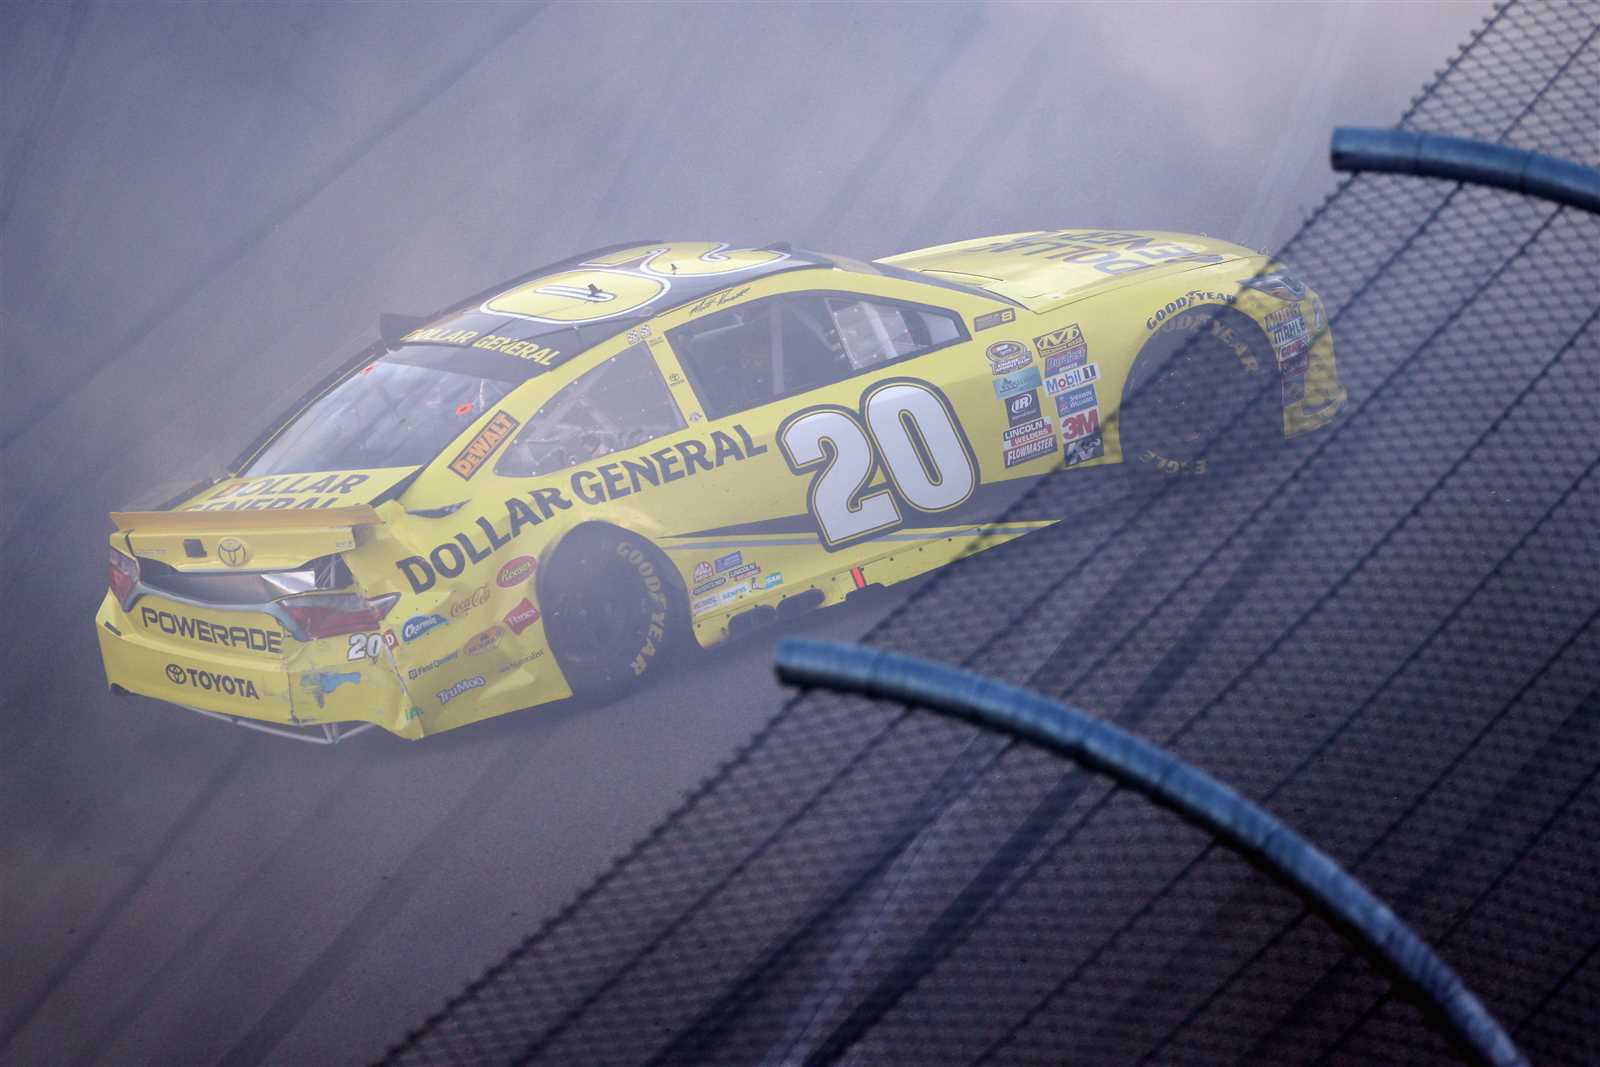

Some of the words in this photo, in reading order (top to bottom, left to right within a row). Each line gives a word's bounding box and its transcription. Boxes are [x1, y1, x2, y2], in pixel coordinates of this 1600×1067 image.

[472, 335, 561, 366] GENERAL
[1046, 369, 1080, 393] Mobil
[1004, 420, 1043, 440] LINCOLN
[1062, 408, 1098, 439] 3M
[776, 376, 981, 552] 20
[1007, 437, 1053, 466] FLOWMASTER
[395, 487, 573, 594] DOLLAR
[569, 424, 768, 505] GENERAL
[616, 541, 668, 677] GOODYEAR
[140, 606, 283, 654] POWERADE
[347, 632, 384, 661] 20
[186, 667, 261, 699] TOYOTA
